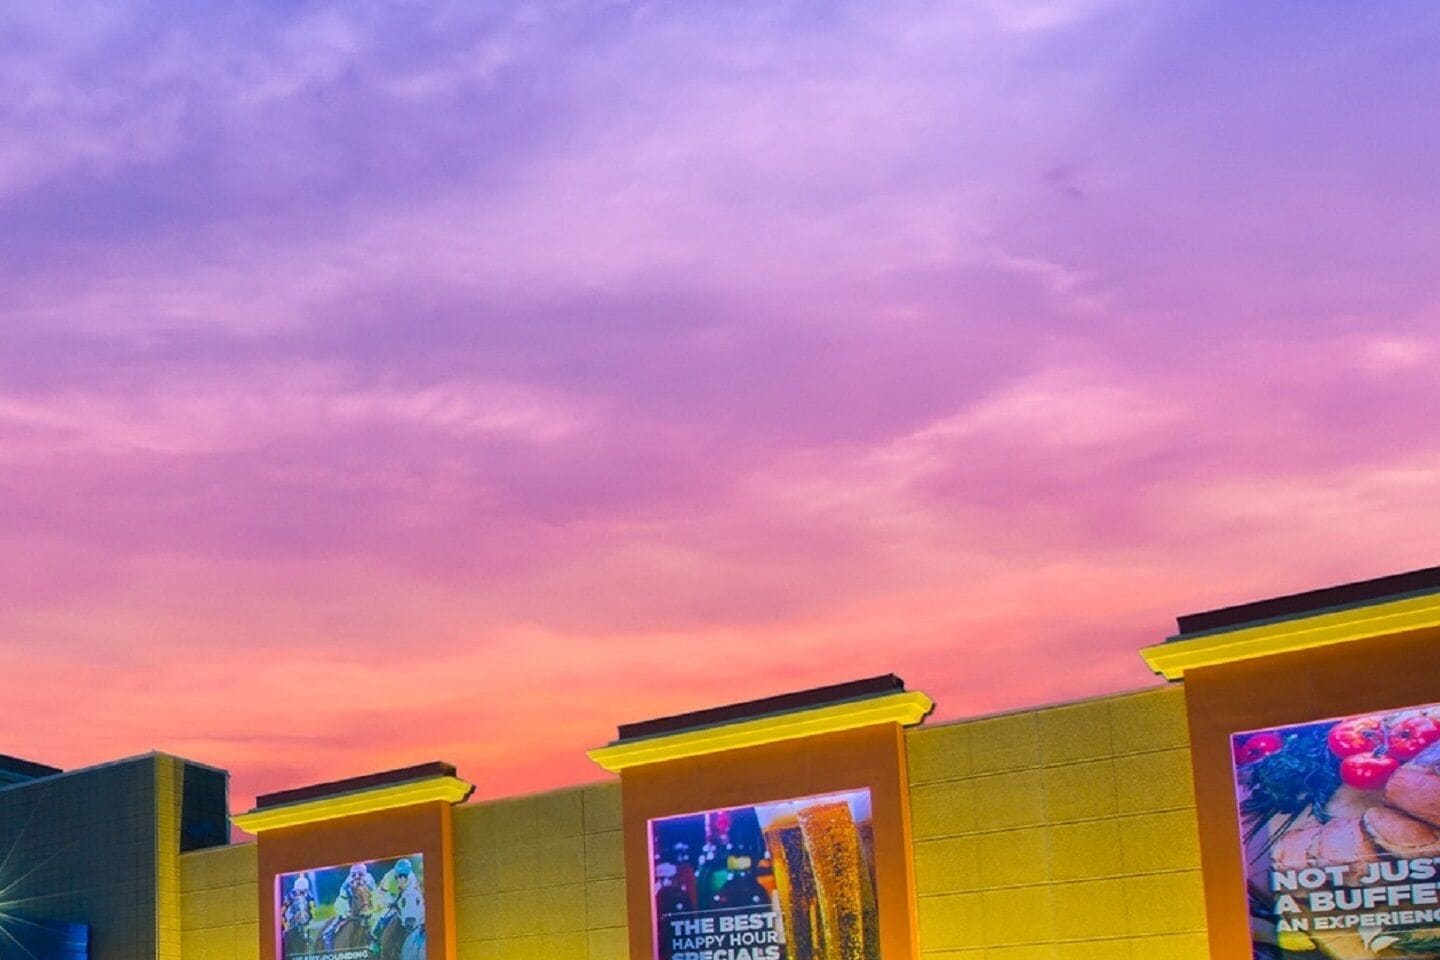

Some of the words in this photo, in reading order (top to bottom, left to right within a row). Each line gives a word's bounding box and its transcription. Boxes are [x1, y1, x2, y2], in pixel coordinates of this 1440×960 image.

[1272, 865, 1349, 892] NOT
[1275, 895, 1300, 914] A
[1310, 882, 1440, 911] BUFFE
[671, 918, 714, 936] THE
[720, 912, 776, 933] BEST
[1279, 917, 1308, 932] AN
[672, 935, 724, 950] HAPPY
[730, 930, 777, 946] HOUR
